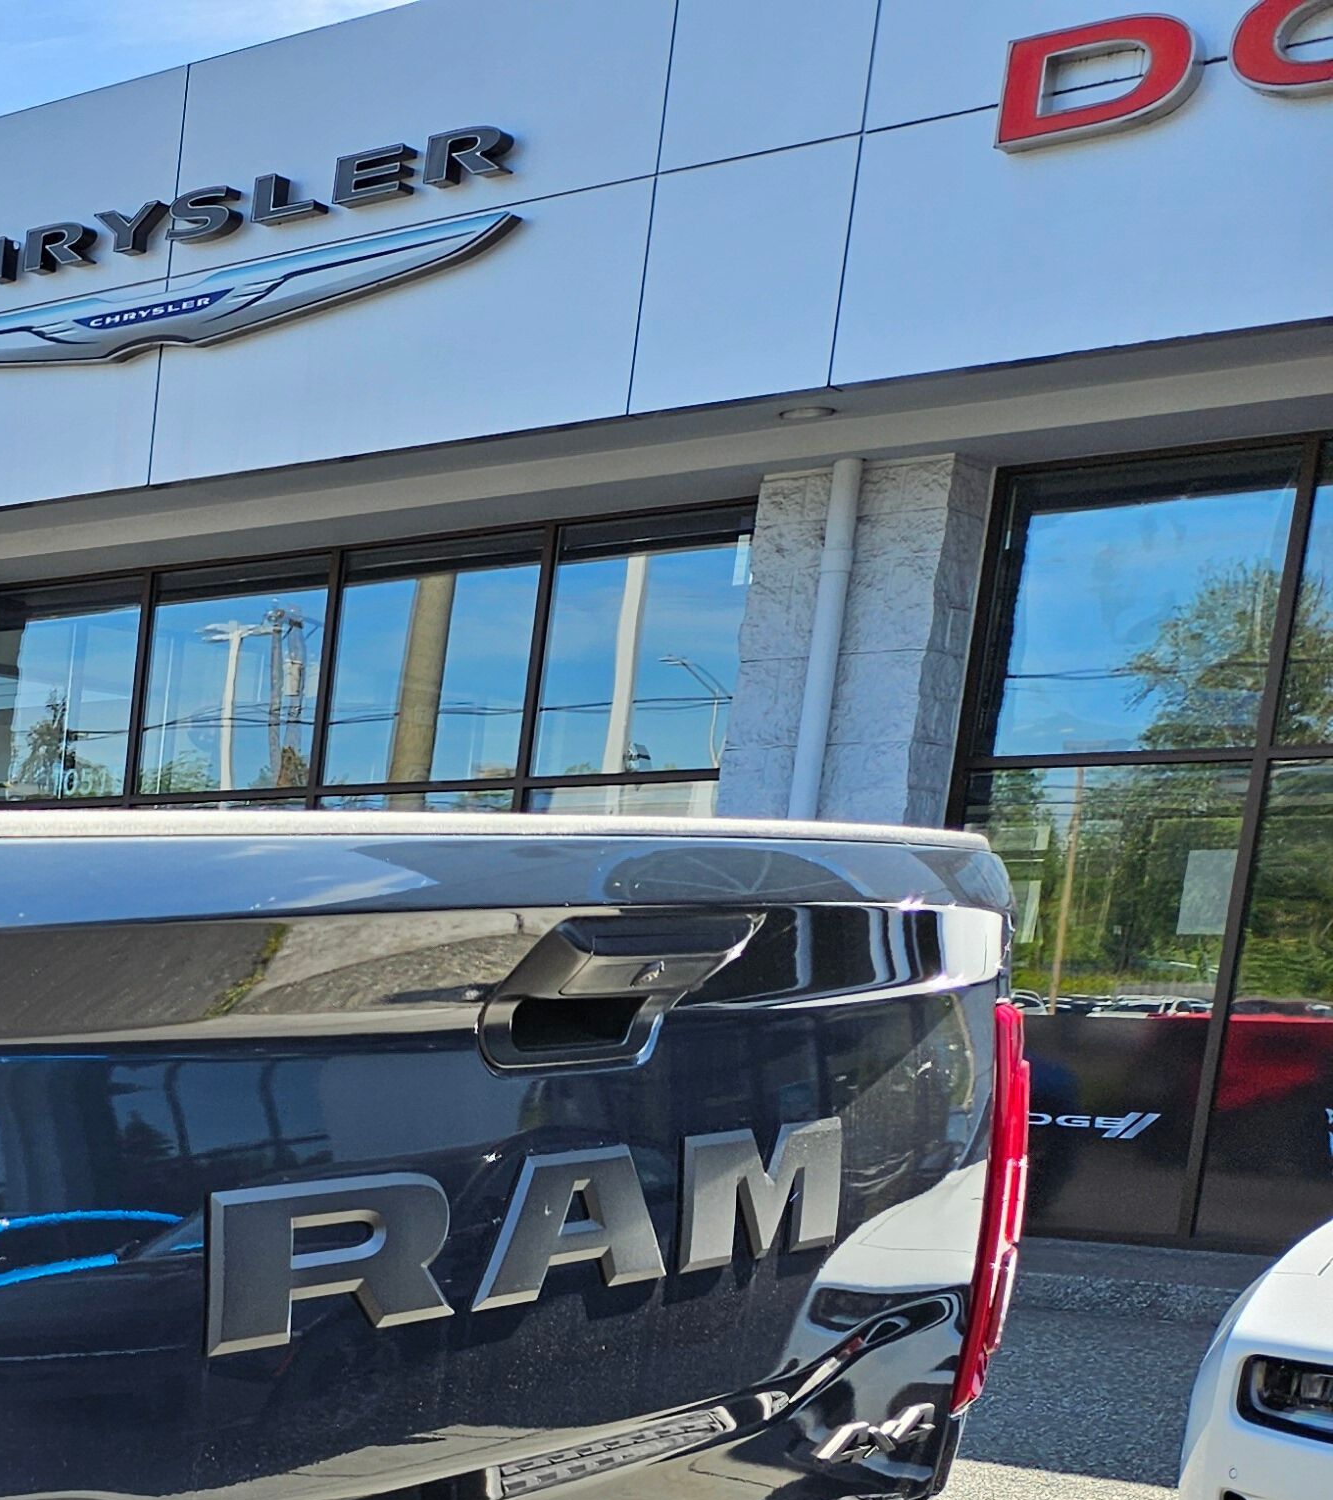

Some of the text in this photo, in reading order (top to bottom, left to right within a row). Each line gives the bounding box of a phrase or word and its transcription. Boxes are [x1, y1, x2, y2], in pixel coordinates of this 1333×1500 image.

[90, 297, 210, 327] CHRYSLER
[1028, 1112, 1126, 1129] DGE
[206, 1116, 842, 1358] RAM
